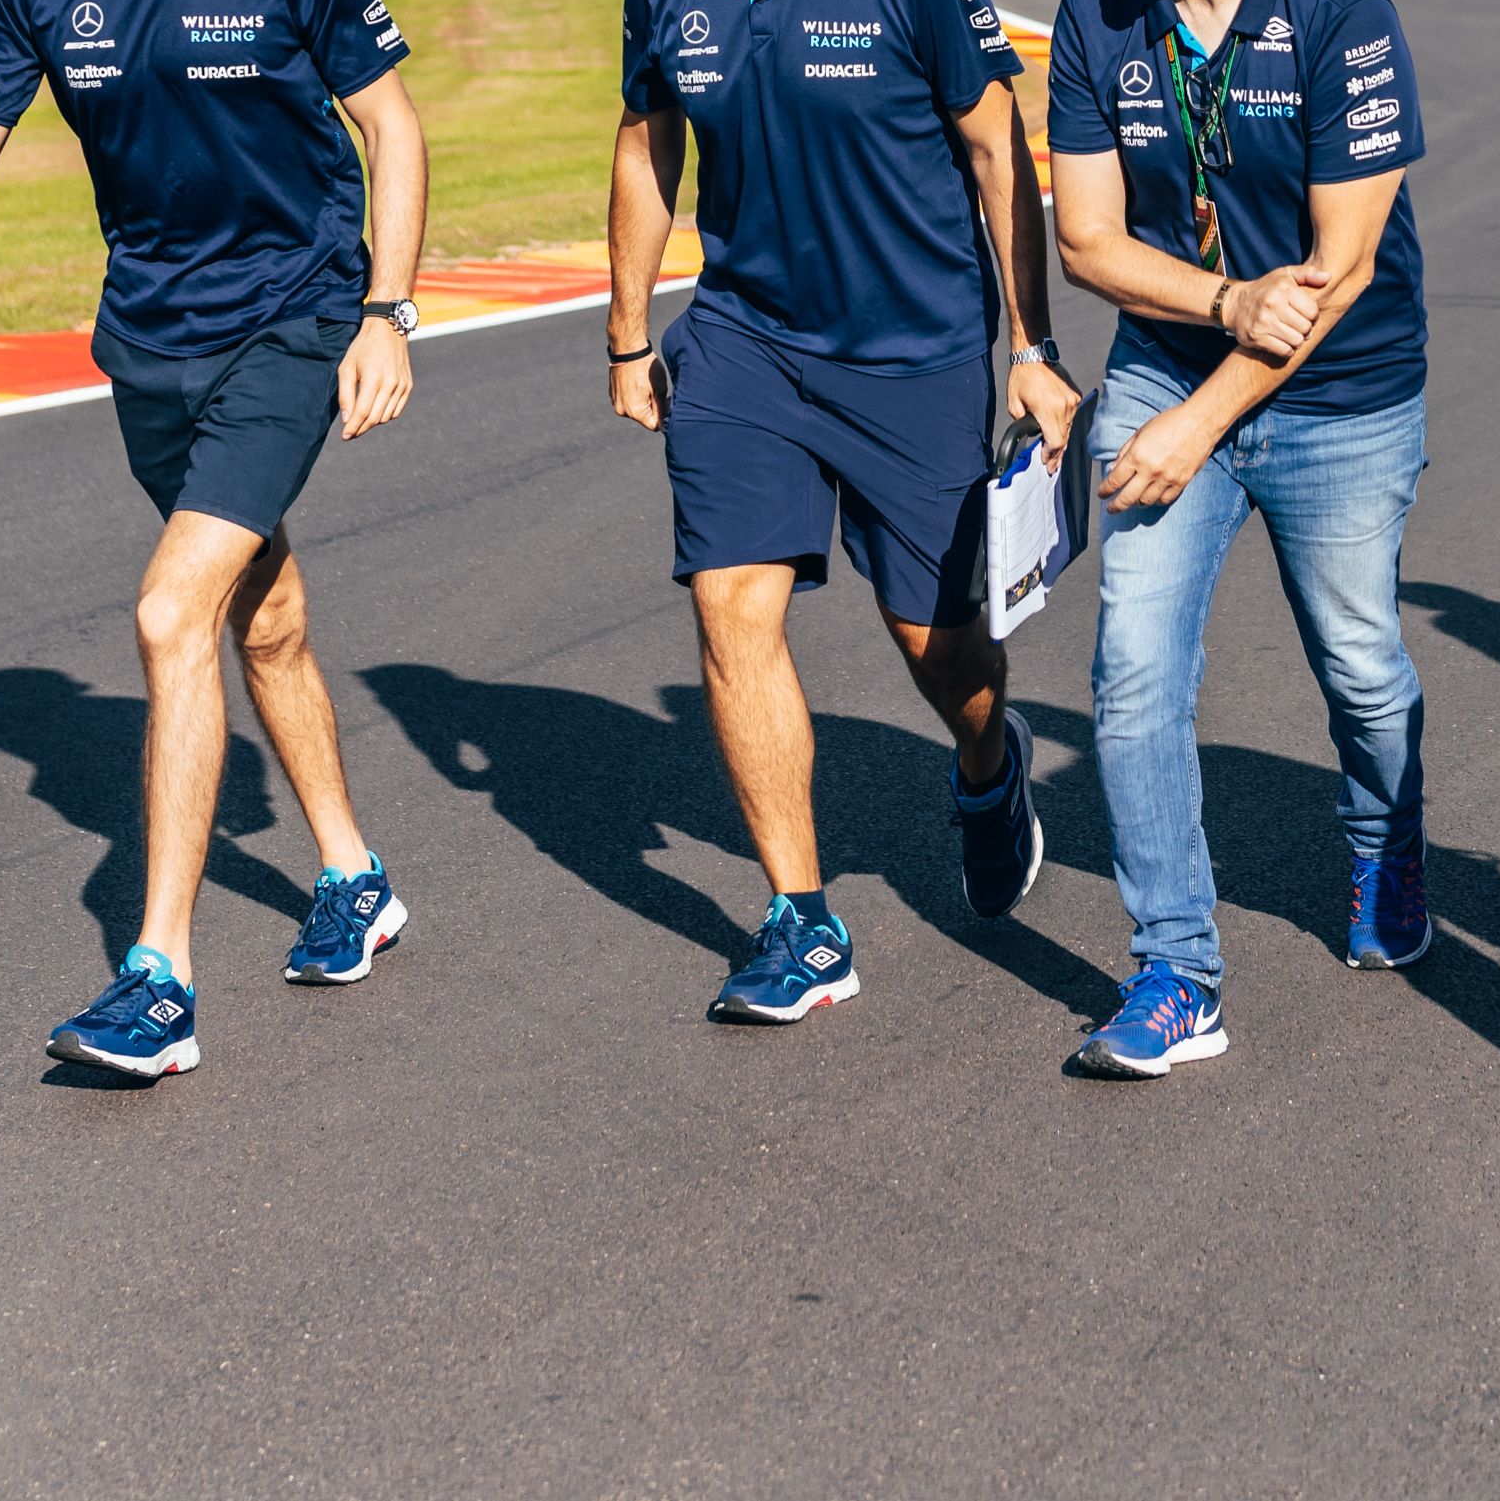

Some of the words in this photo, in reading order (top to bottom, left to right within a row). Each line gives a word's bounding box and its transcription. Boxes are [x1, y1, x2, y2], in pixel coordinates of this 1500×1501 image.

[182, 15, 265, 28] WILLIAMS
[803, 20, 882, 35] WILLIAMS
[190, 29, 256, 43] RACING
[810, 35, 872, 48] RACING
[1253, 41, 1293, 52] umbro
[1345, 35, 1390, 61] BREMONT
[187, 64, 260, 79] DURACELL
[805, 63, 877, 78] DURACELL
[68, 79, 102, 89] Ventures
[678, 84, 706, 93] Ventures
[1230, 88, 1302, 105] WILLIAMS
[1238, 104, 1295, 118] RACING
[1351, 104, 1396, 125] SOFINA
[1349, 130, 1401, 155] LAVAZZA
